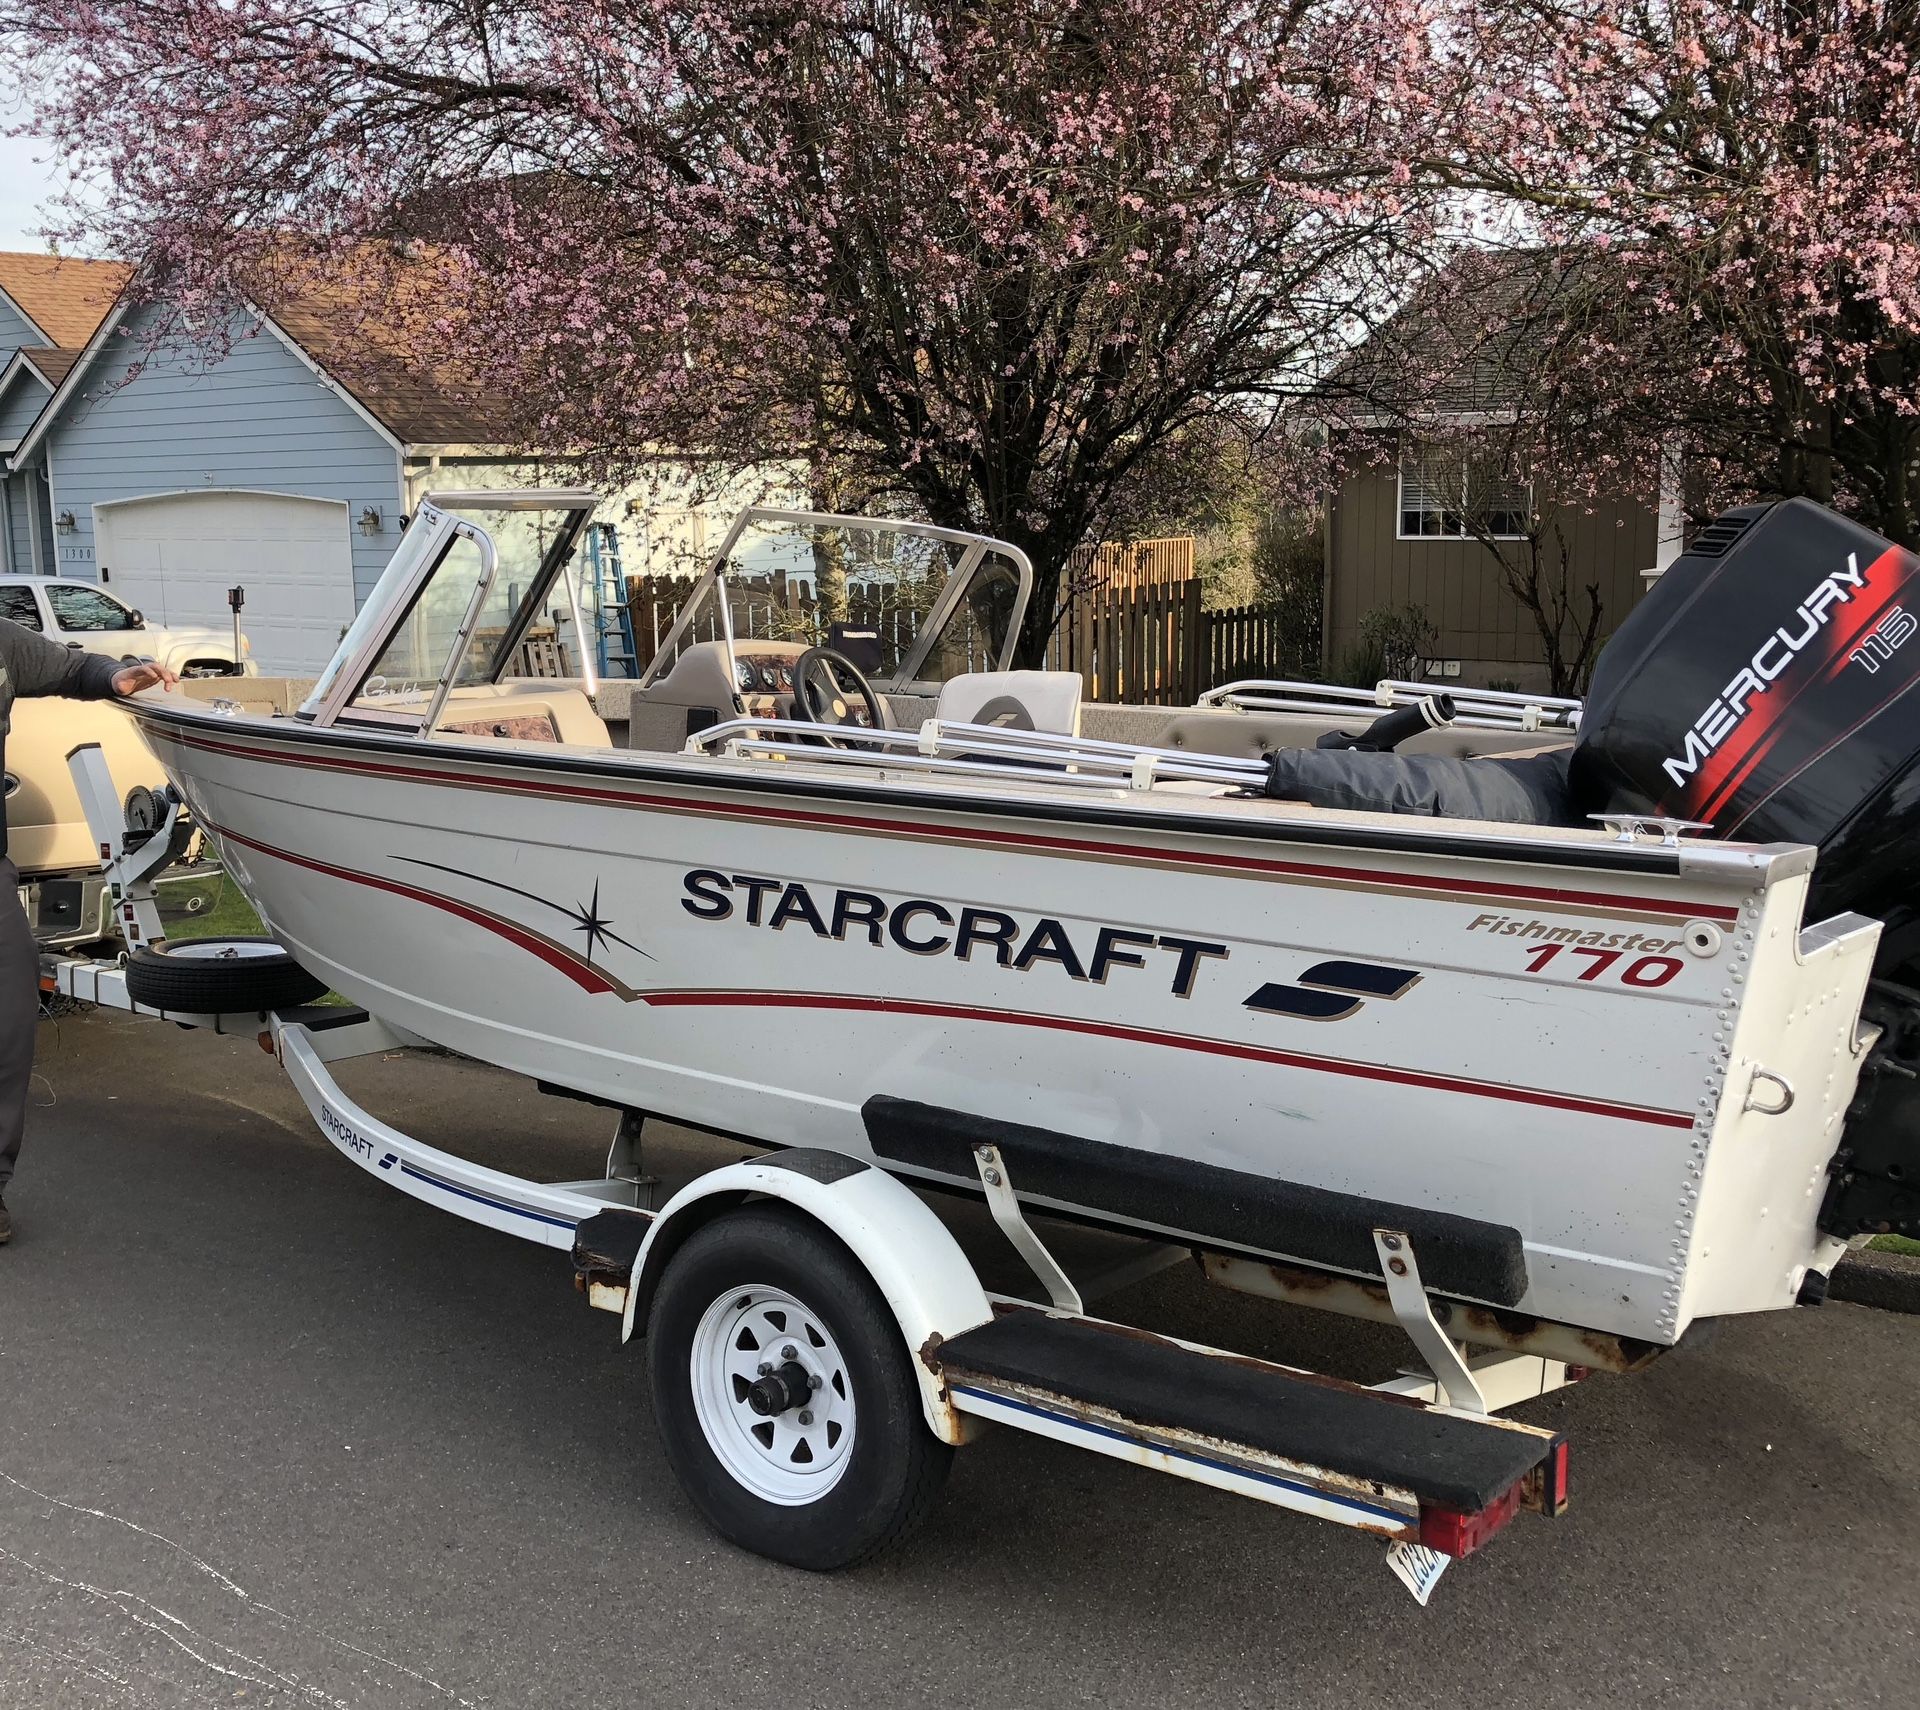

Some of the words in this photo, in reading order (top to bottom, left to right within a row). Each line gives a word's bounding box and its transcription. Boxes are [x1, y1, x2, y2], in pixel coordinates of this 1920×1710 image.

[1662, 552, 1865, 788] MERCURY
[1849, 606, 1918, 674] 115
[681, 869, 1230, 1000] STARCRAFT
[1466, 913, 1686, 954] Fishmaster
[1525, 943, 1685, 987] 170
[321, 1104, 375, 1160] STARCRAFT
